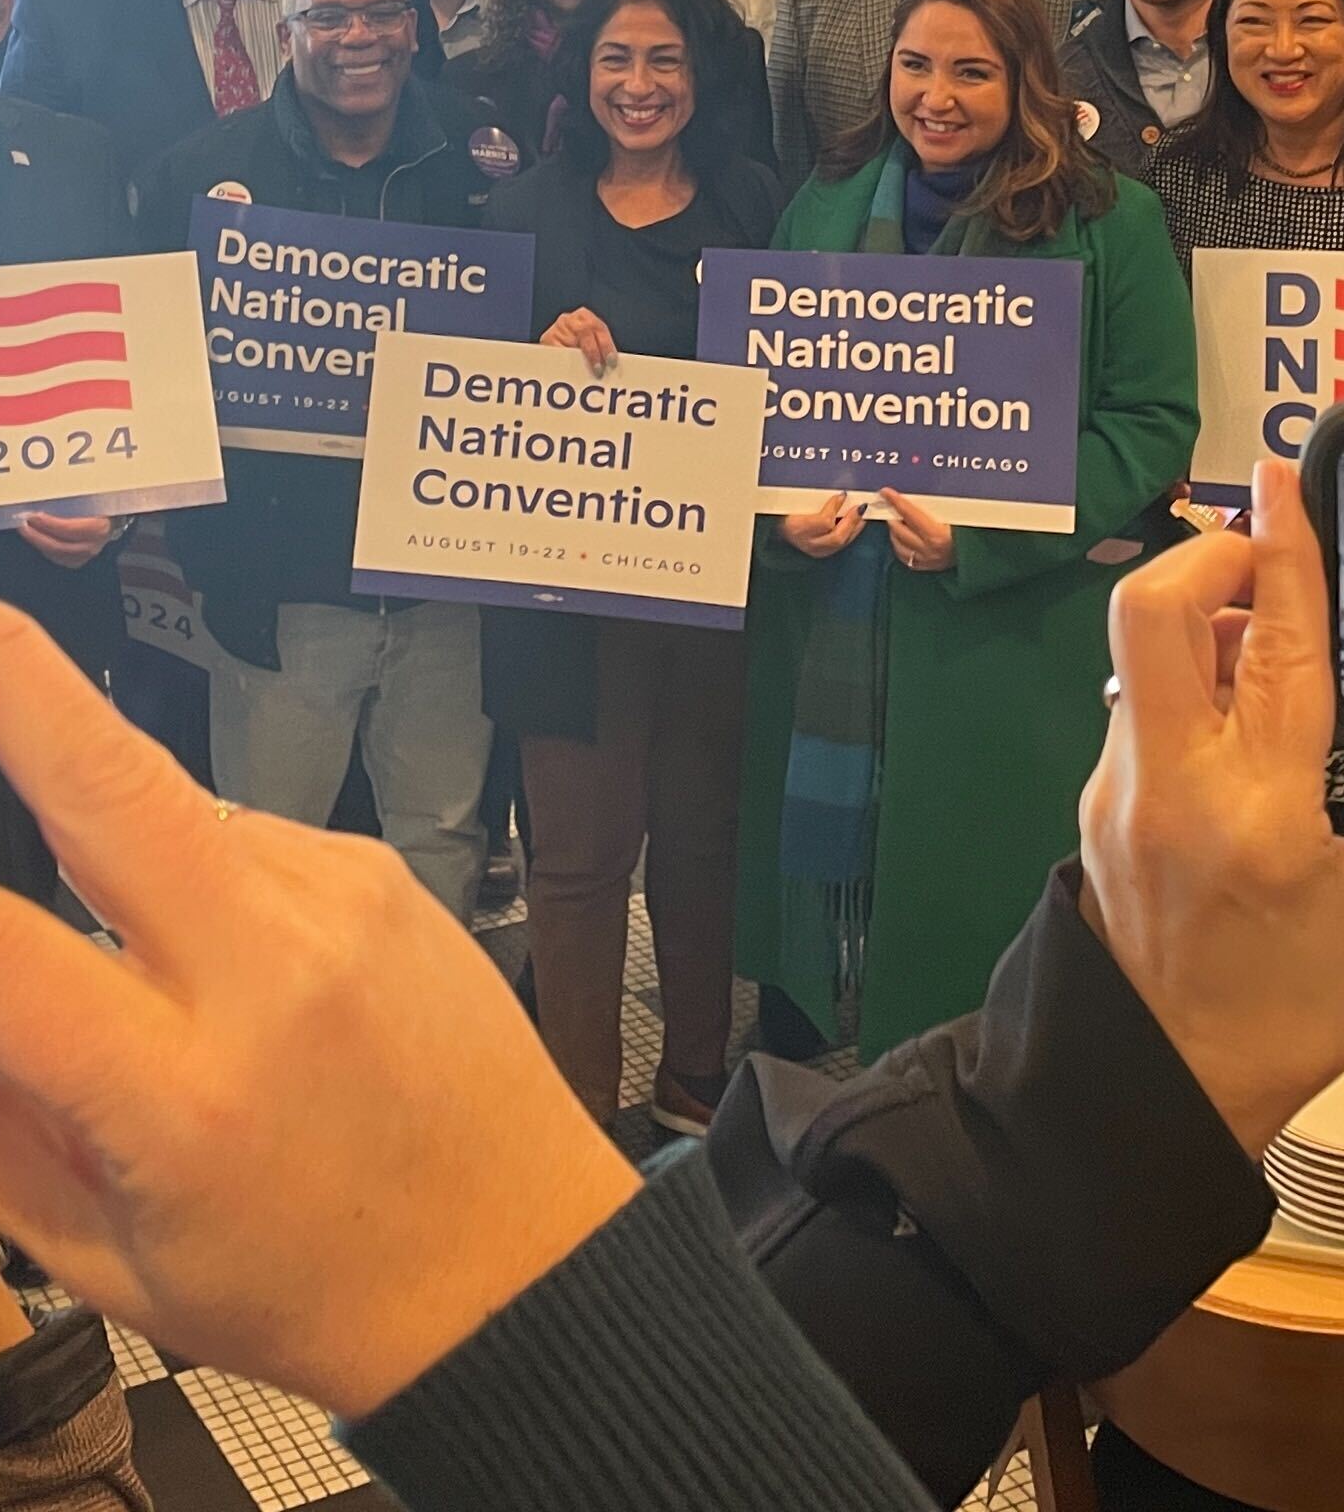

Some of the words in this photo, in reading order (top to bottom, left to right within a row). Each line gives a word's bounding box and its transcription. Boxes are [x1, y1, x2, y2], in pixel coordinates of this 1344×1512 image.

[217, 228, 487, 293] Democratic
[210, 278, 406, 332] National
[749, 278, 1034, 328] Democratic
[206, 327, 375, 377] Conven
[746, 329, 955, 375] National
[213, 389, 282, 405] UGUST
[293, 396, 350, 411] 19-22
[423, 361, 718, 427] Democratic
[417, 415, 633, 471] National
[761, 445, 830, 461] UGUST
[841, 448, 900, 465] 19-22
[932, 454, 1029, 473] CHICAGO
[411, 468, 706, 533] Convention
[407, 534, 496, 553] AUGUST
[508, 542, 567, 560] 19-22
[601, 553, 702, 575] CHICAGO
[121, 593, 195, 641] 024
